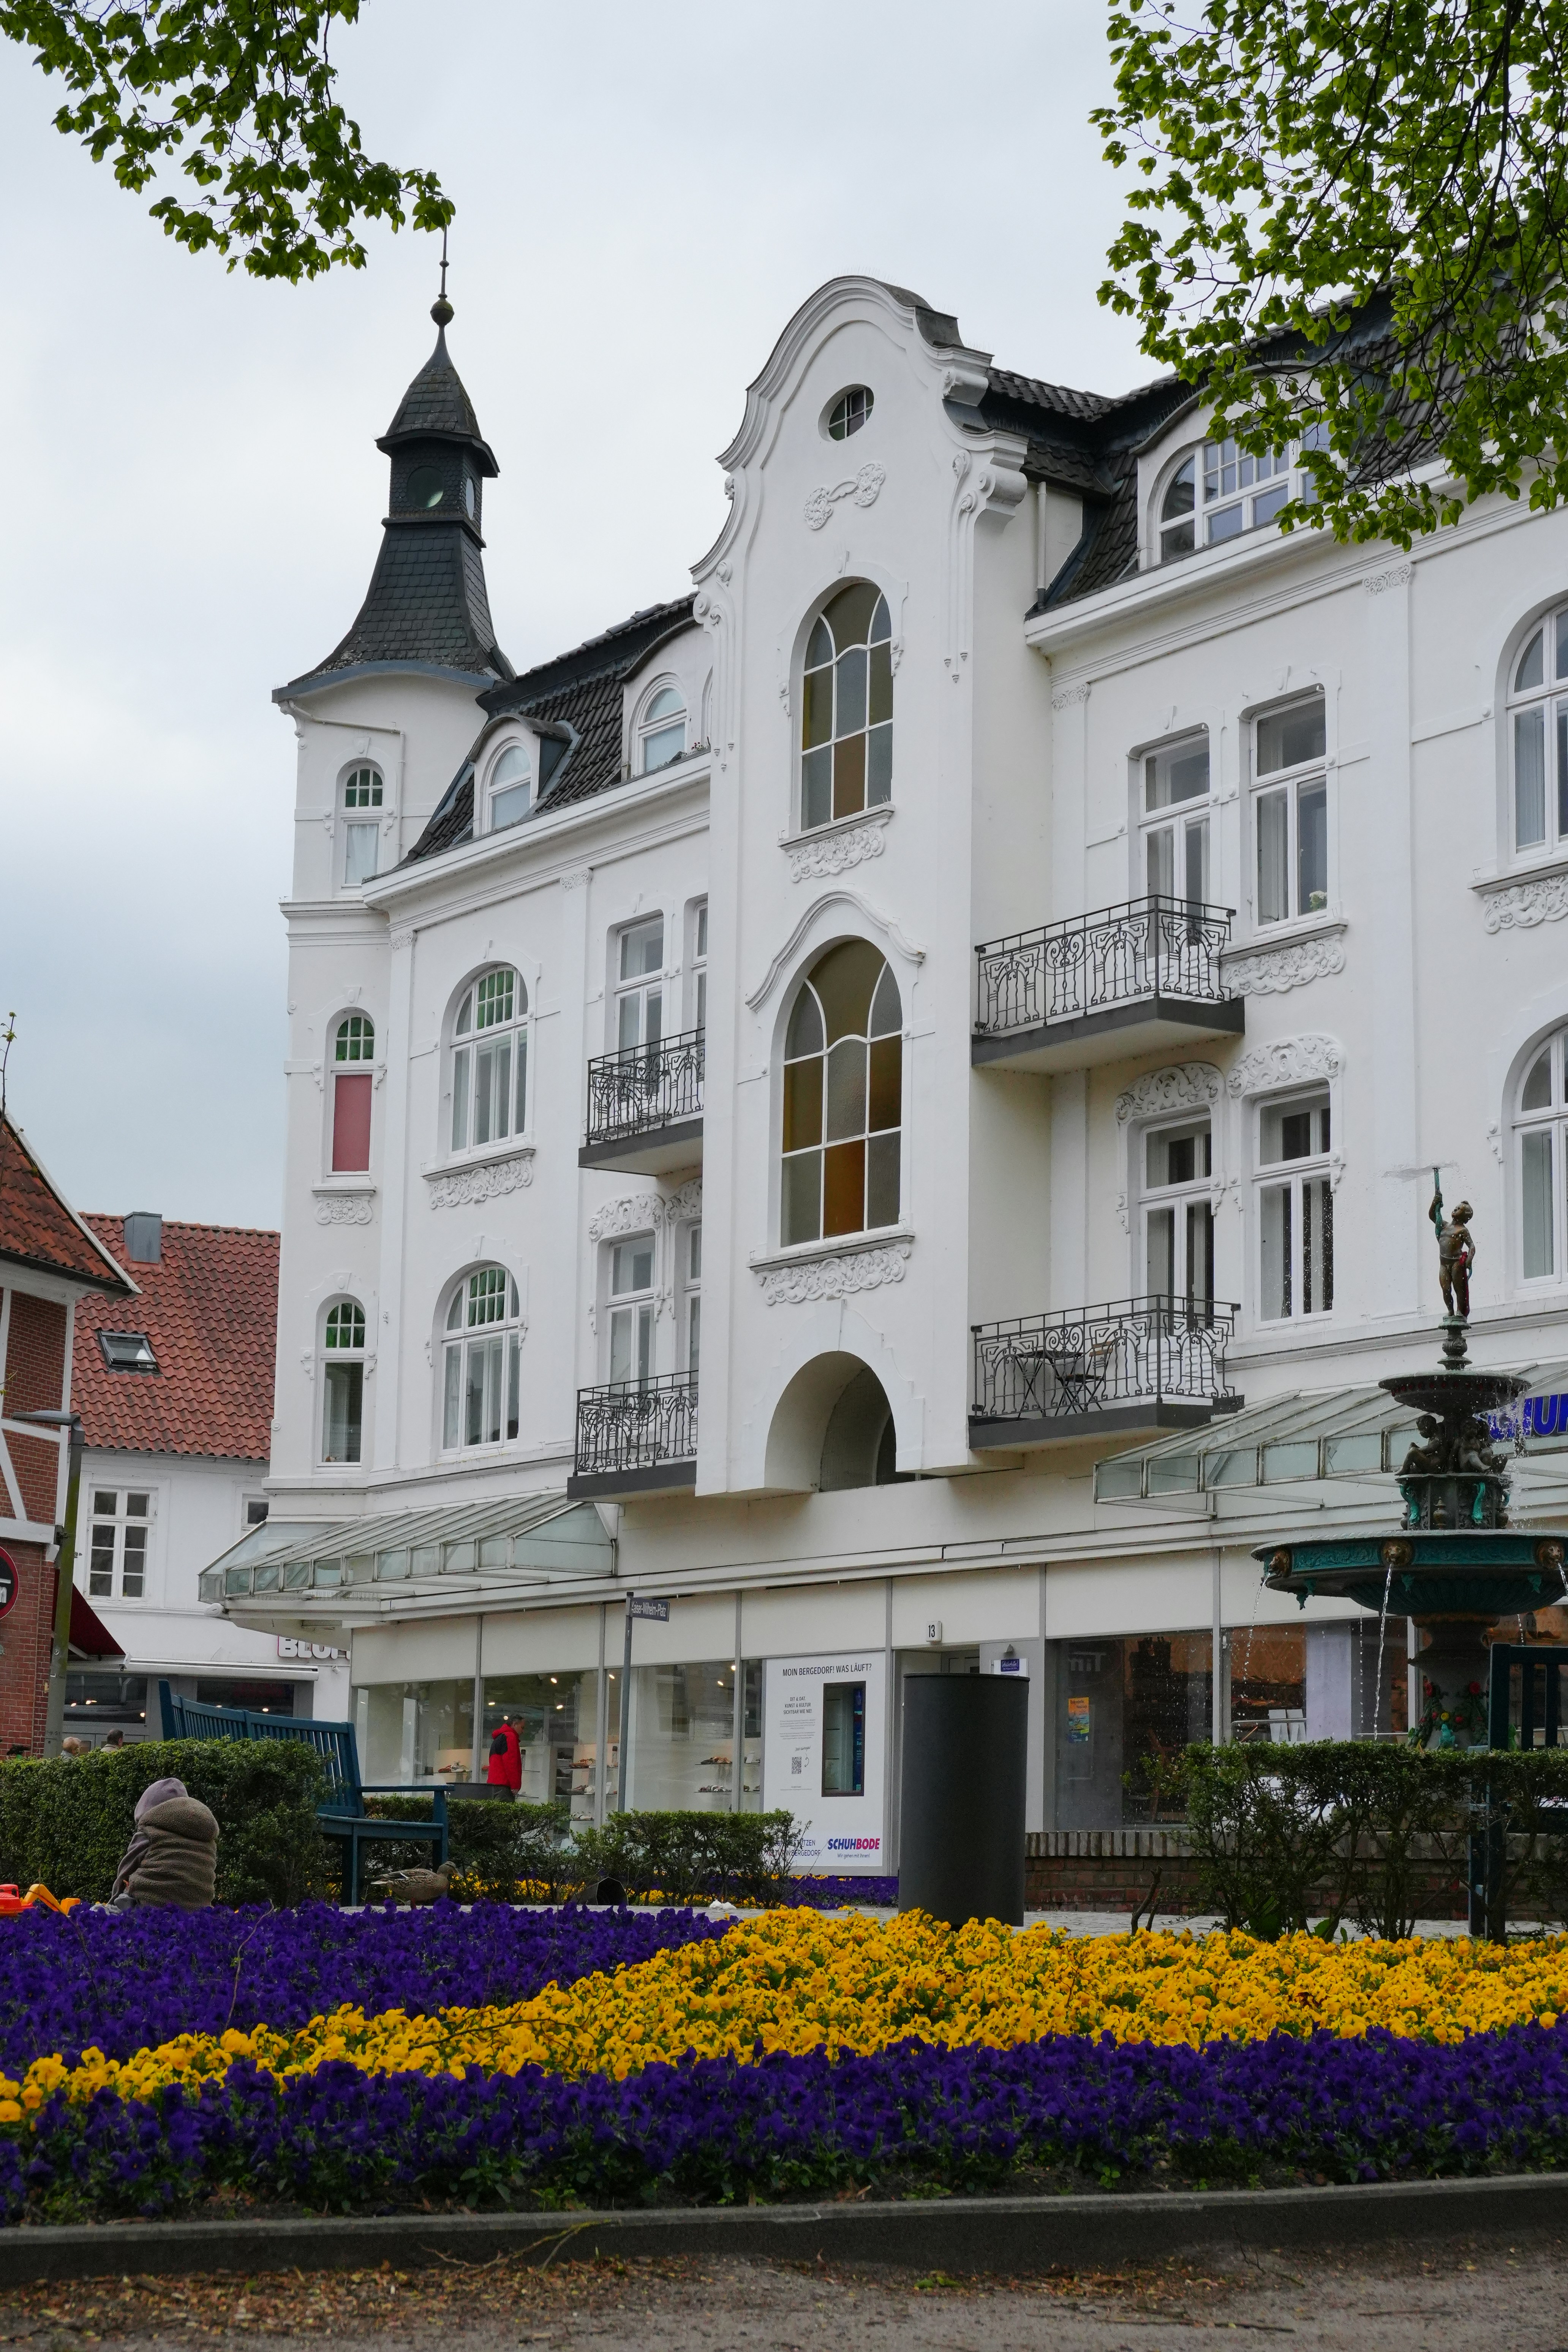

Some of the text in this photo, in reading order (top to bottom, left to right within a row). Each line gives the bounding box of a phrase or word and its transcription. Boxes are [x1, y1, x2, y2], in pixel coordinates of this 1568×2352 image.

[631, 1601, 666, 1617] Kaiser-Wilhelm-Platz
[928, 1624, 935, 1638] 13
[782, 1662, 872, 1677] MOIN BERGEDORF! WAS LÄUFT?
[828, 1838, 880, 1849] SCHUHBODE
